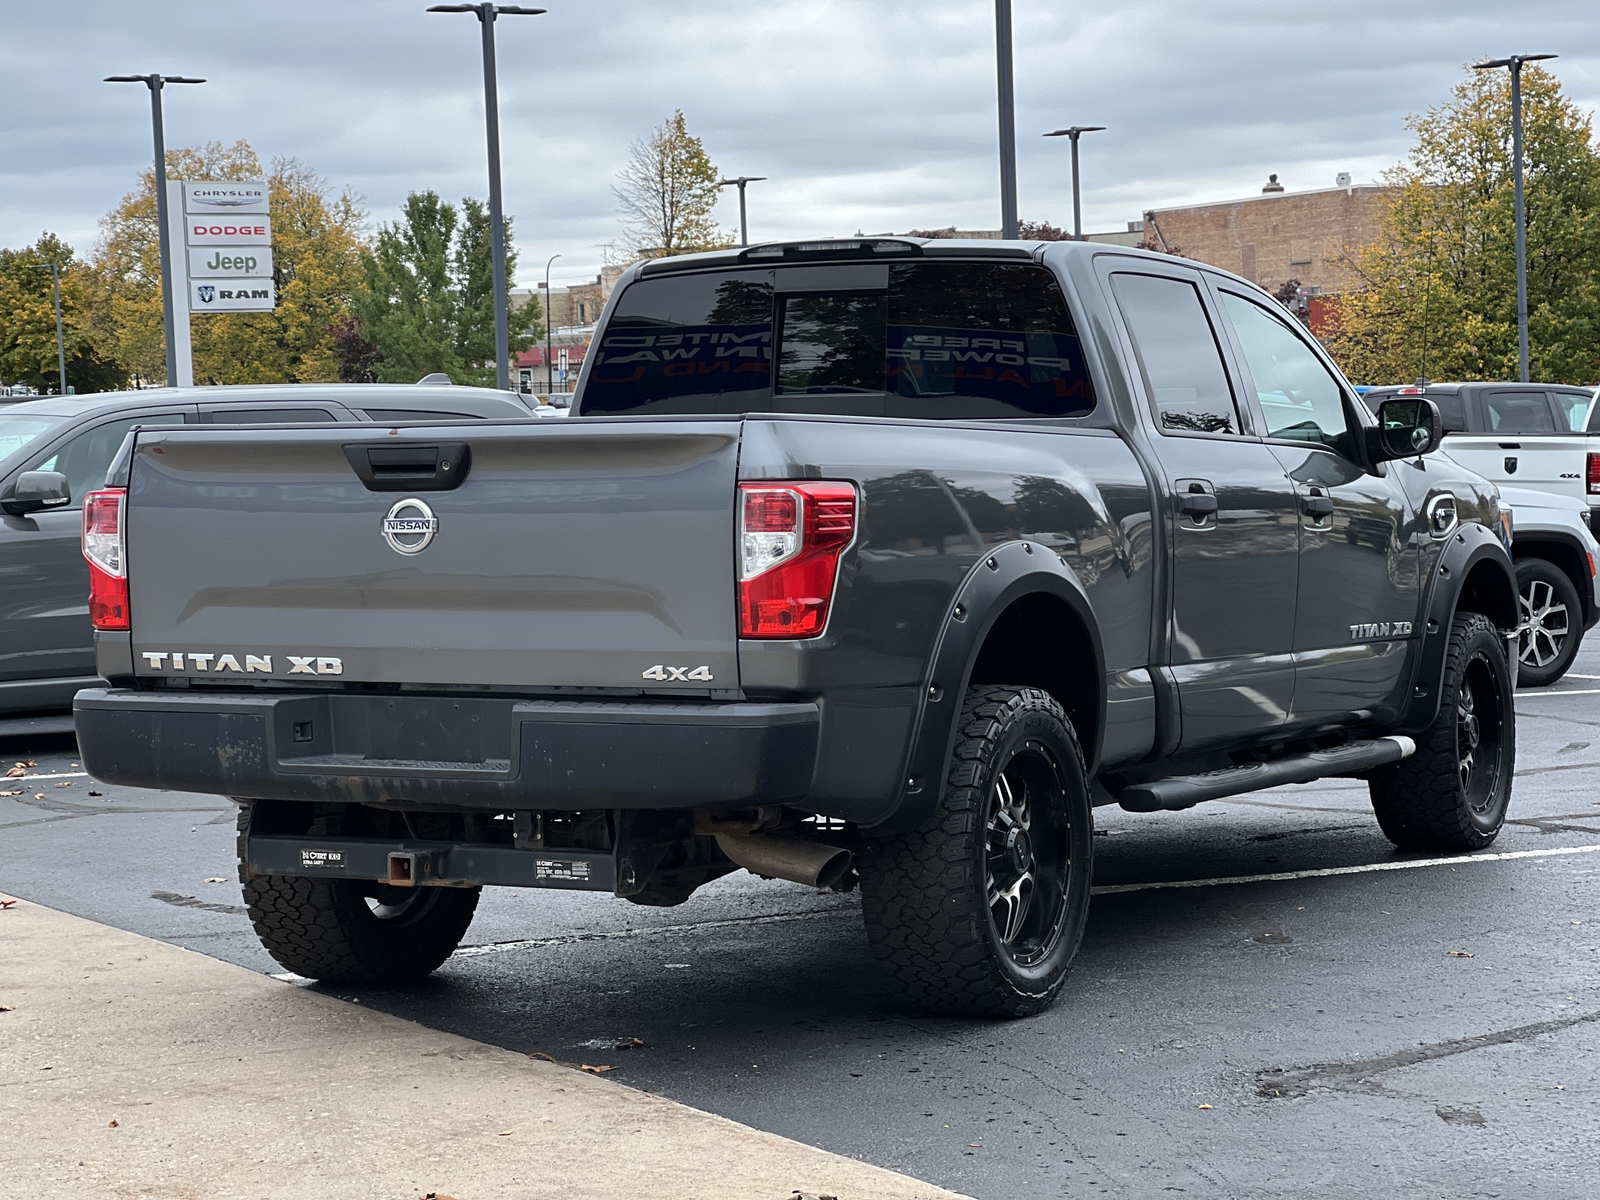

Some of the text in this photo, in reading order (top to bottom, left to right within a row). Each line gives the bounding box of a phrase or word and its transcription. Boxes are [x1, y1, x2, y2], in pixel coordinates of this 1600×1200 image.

[193, 226, 266, 236] DODGE
[206, 251, 258, 274] Jeep
[219, 290, 269, 299] RAM
[387, 521, 431, 530] NISSAN
[1349, 621, 1413, 640] TITAN XD
[142, 651, 343, 676] TITAN XD
